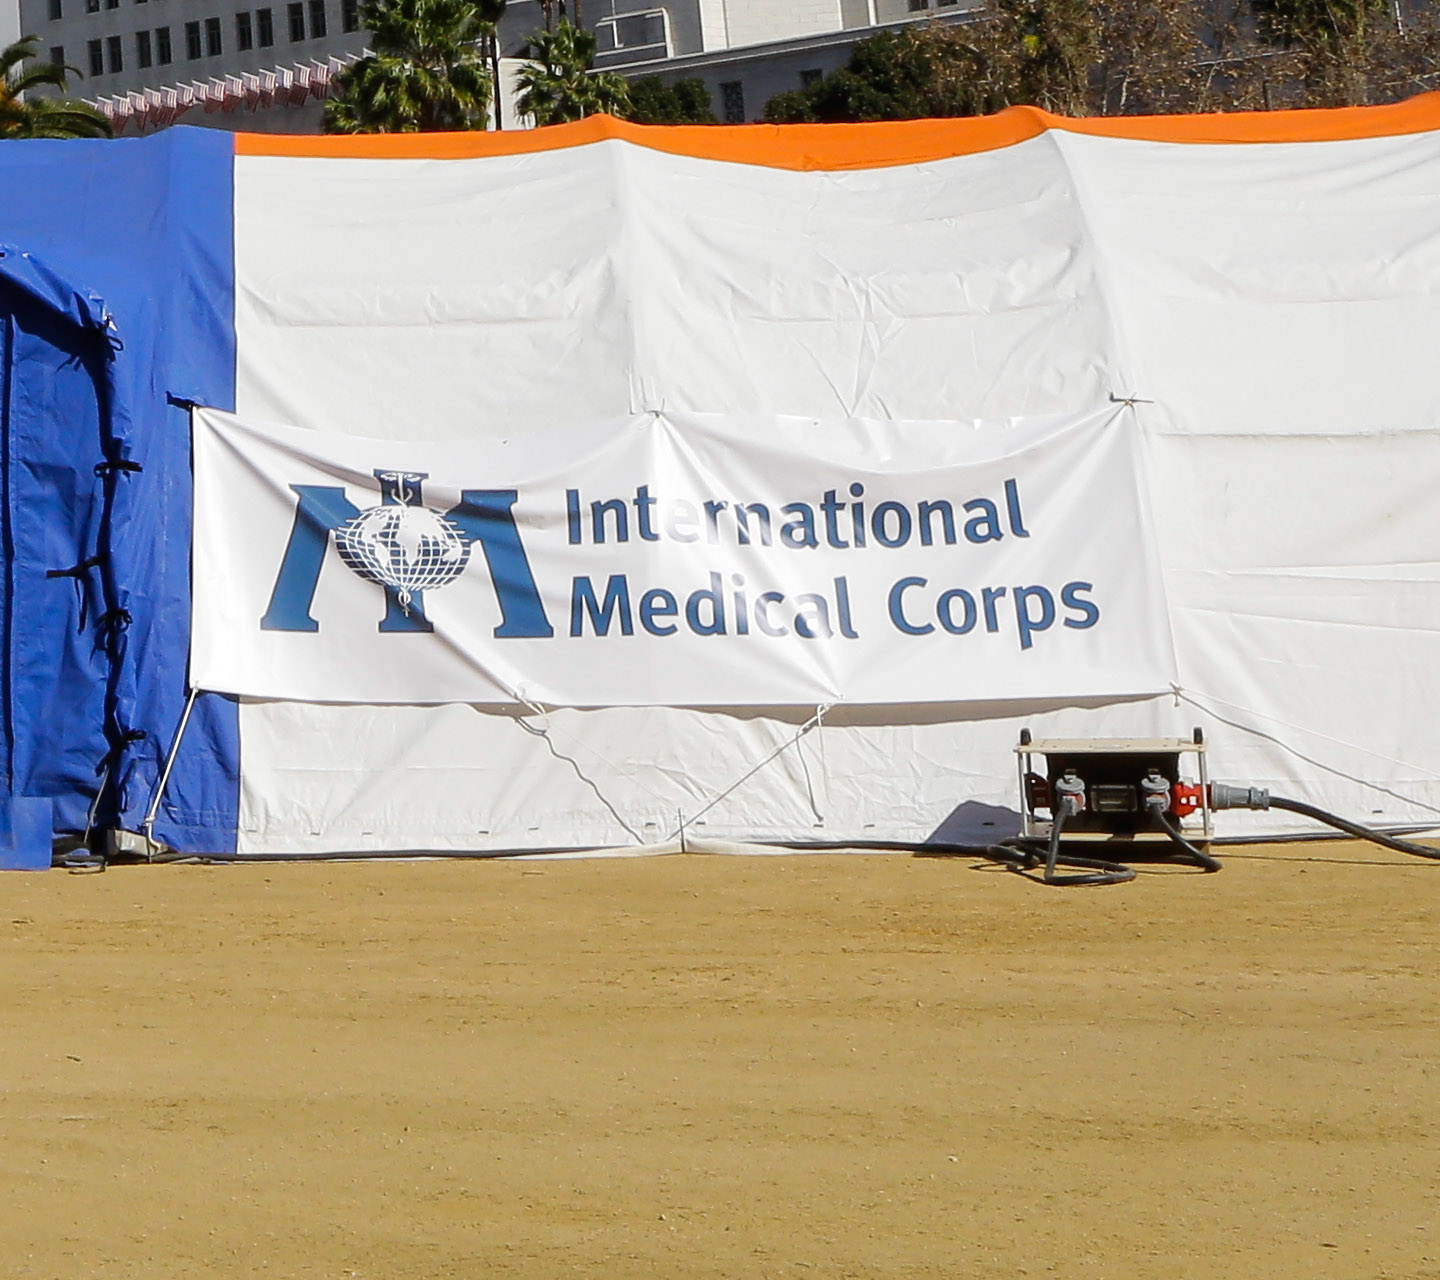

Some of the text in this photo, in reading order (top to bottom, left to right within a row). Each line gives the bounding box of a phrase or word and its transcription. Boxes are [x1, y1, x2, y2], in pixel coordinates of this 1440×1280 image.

[566, 479, 1030, 549] International
[570, 572, 1100, 649] Medical Corps
